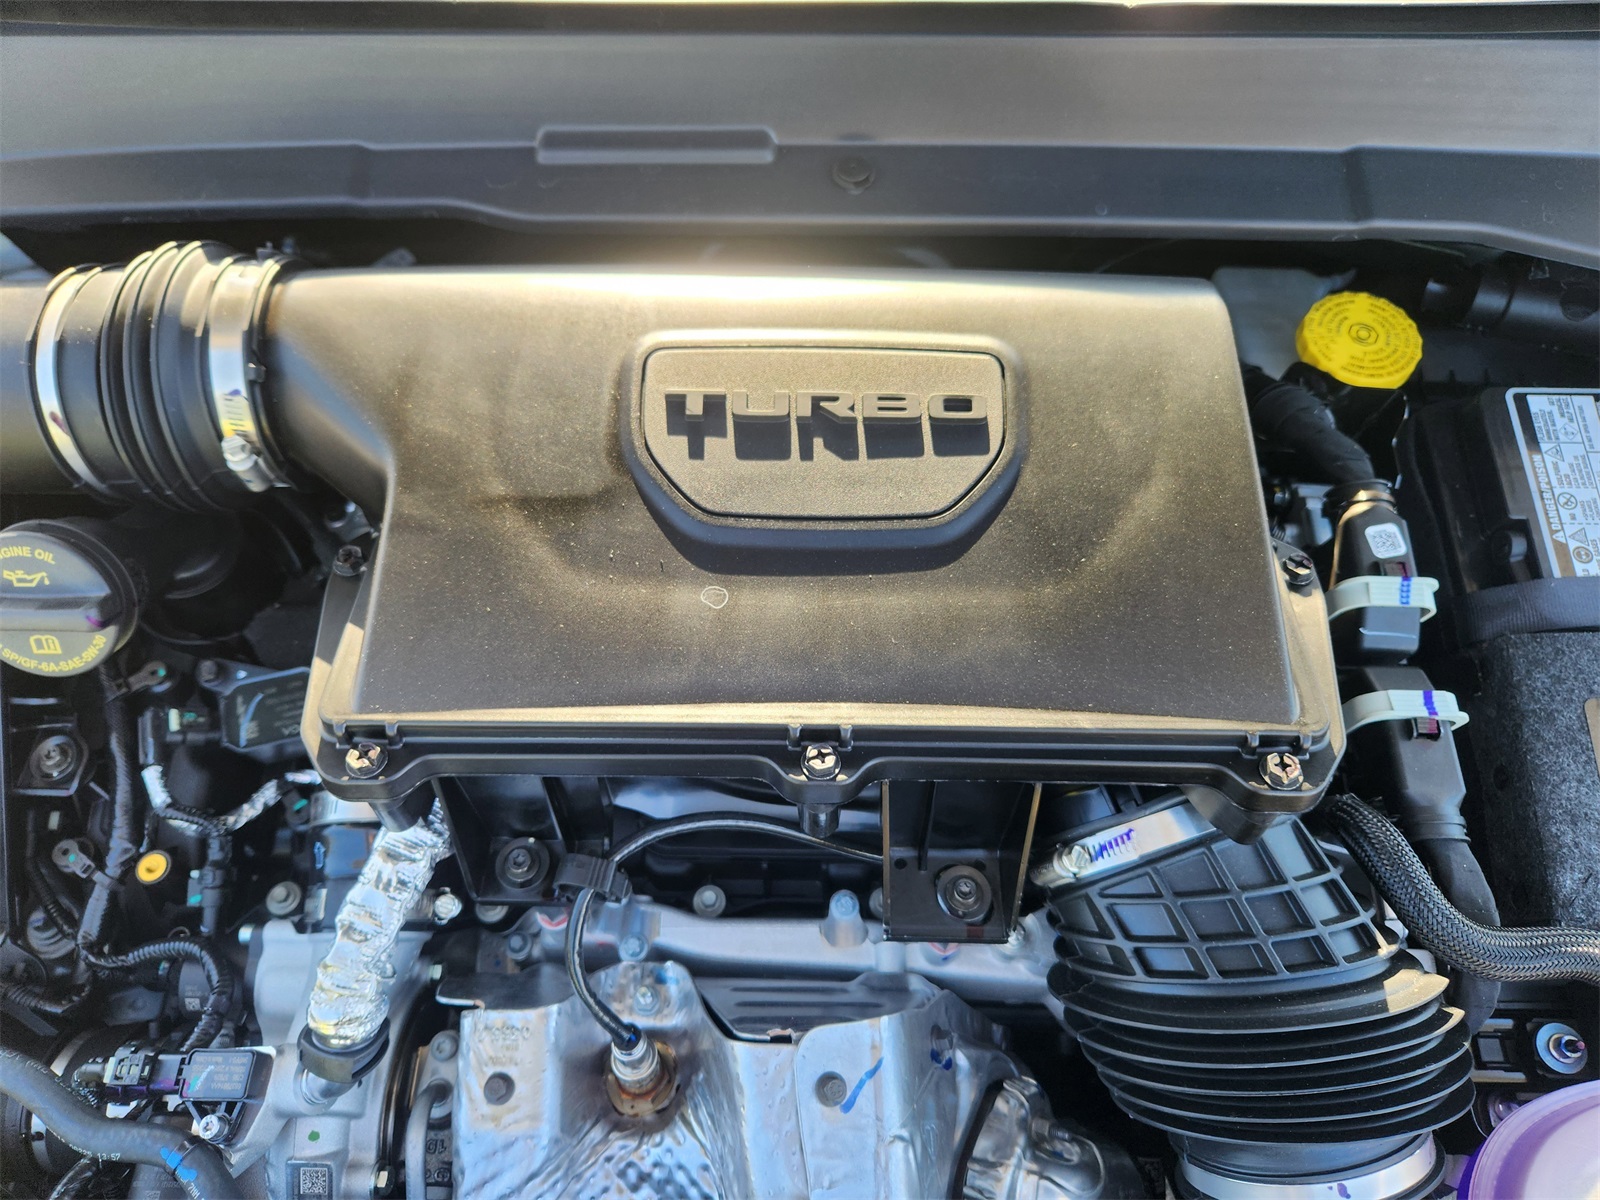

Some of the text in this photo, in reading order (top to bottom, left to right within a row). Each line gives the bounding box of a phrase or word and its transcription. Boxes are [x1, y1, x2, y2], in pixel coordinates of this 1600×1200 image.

[664, 389, 988, 424] TURBO
[1531, 454, 1561, 529] DANGER/POISON
[0, 545, 56, 565] GINE OIL
